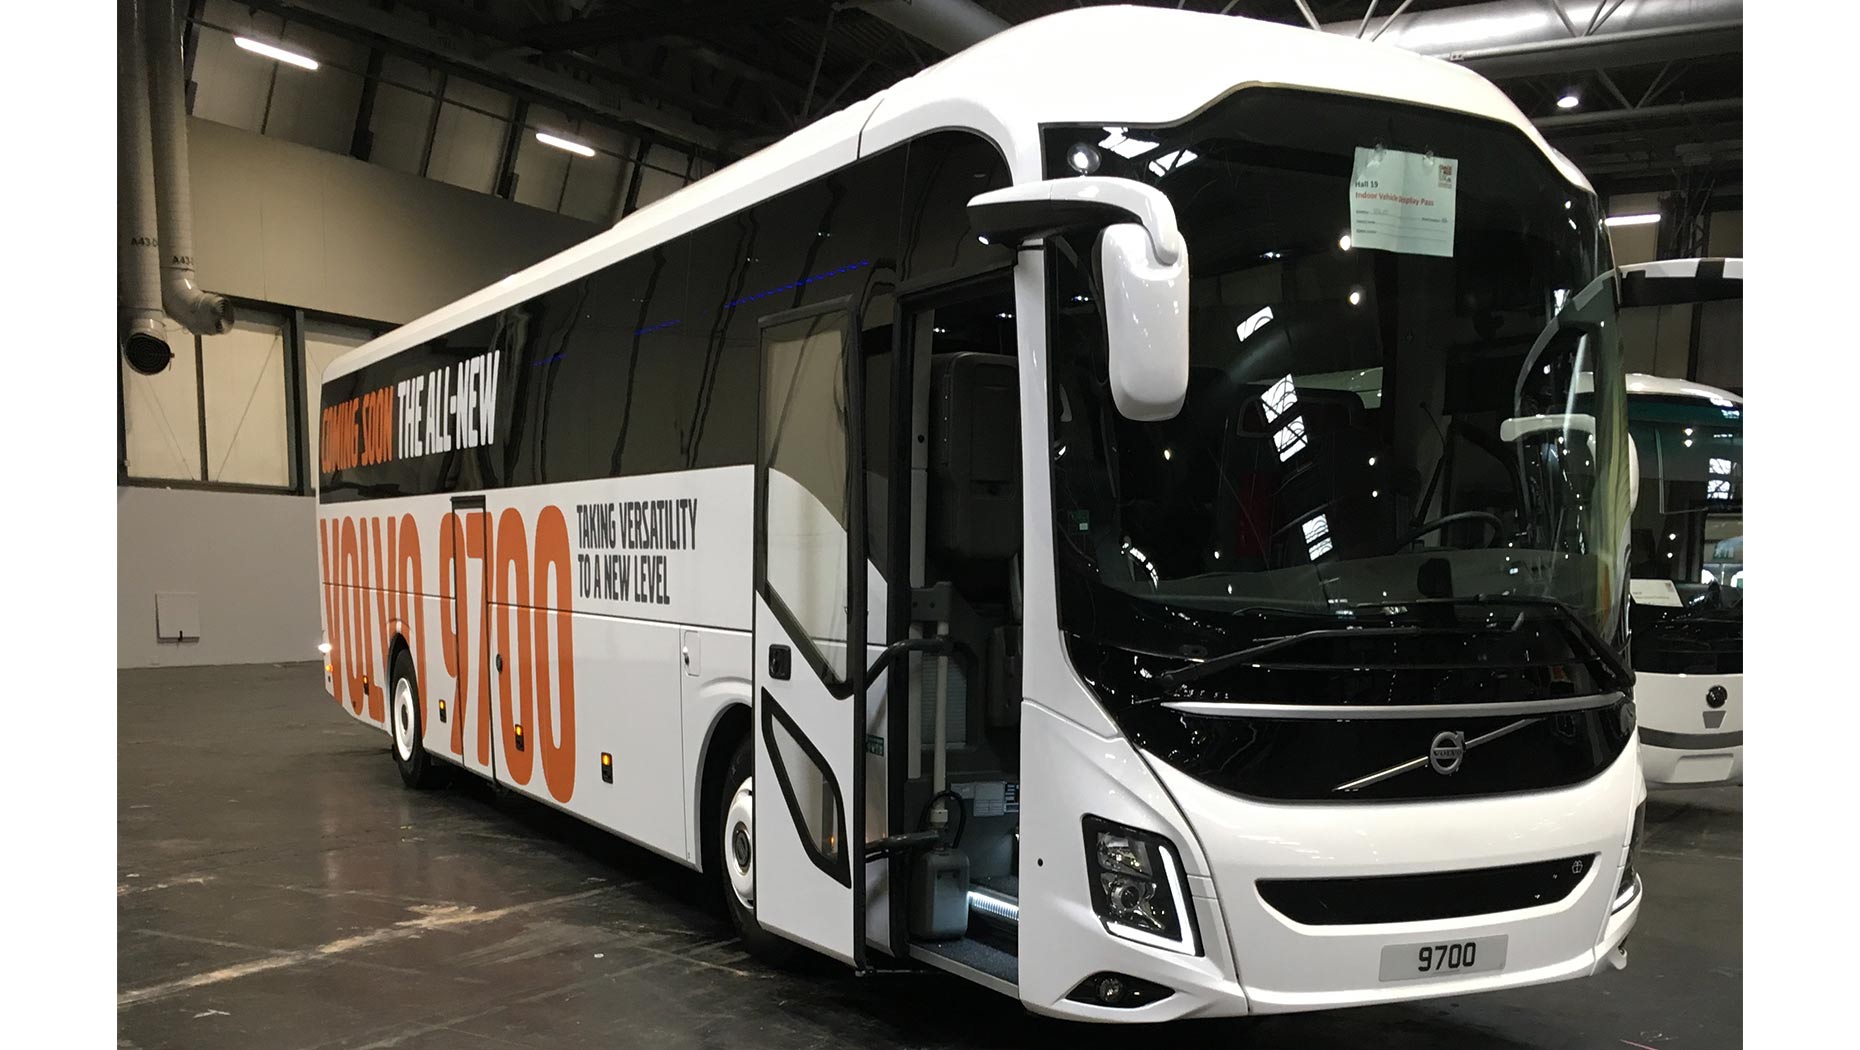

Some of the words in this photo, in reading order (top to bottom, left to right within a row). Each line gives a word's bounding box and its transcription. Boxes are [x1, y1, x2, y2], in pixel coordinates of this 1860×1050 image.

[1355, 180, 1369, 188] Hall
[1370, 180, 1379, 188] 19
[1355, 191, 1377, 200] Indoor
[1420, 198, 1434, 206] Pass
[322, 397, 360, 474] COMING
[361, 385, 394, 466] SOON
[398, 375, 424, 460] THE
[425, 350, 500, 456] ALL-NEW
[576, 502, 616, 549] TAKING
[619, 498, 698, 550] VERSATILITY
[578, 553, 591, 599] TO
[593, 554, 602, 599] A
[604, 554, 631, 602] NEW
[634, 554, 670, 605] LEVEL
[320, 512, 428, 740] VOLVO
[439, 505, 576, 803] 9700
[1418, 942, 1476, 972] 9700
